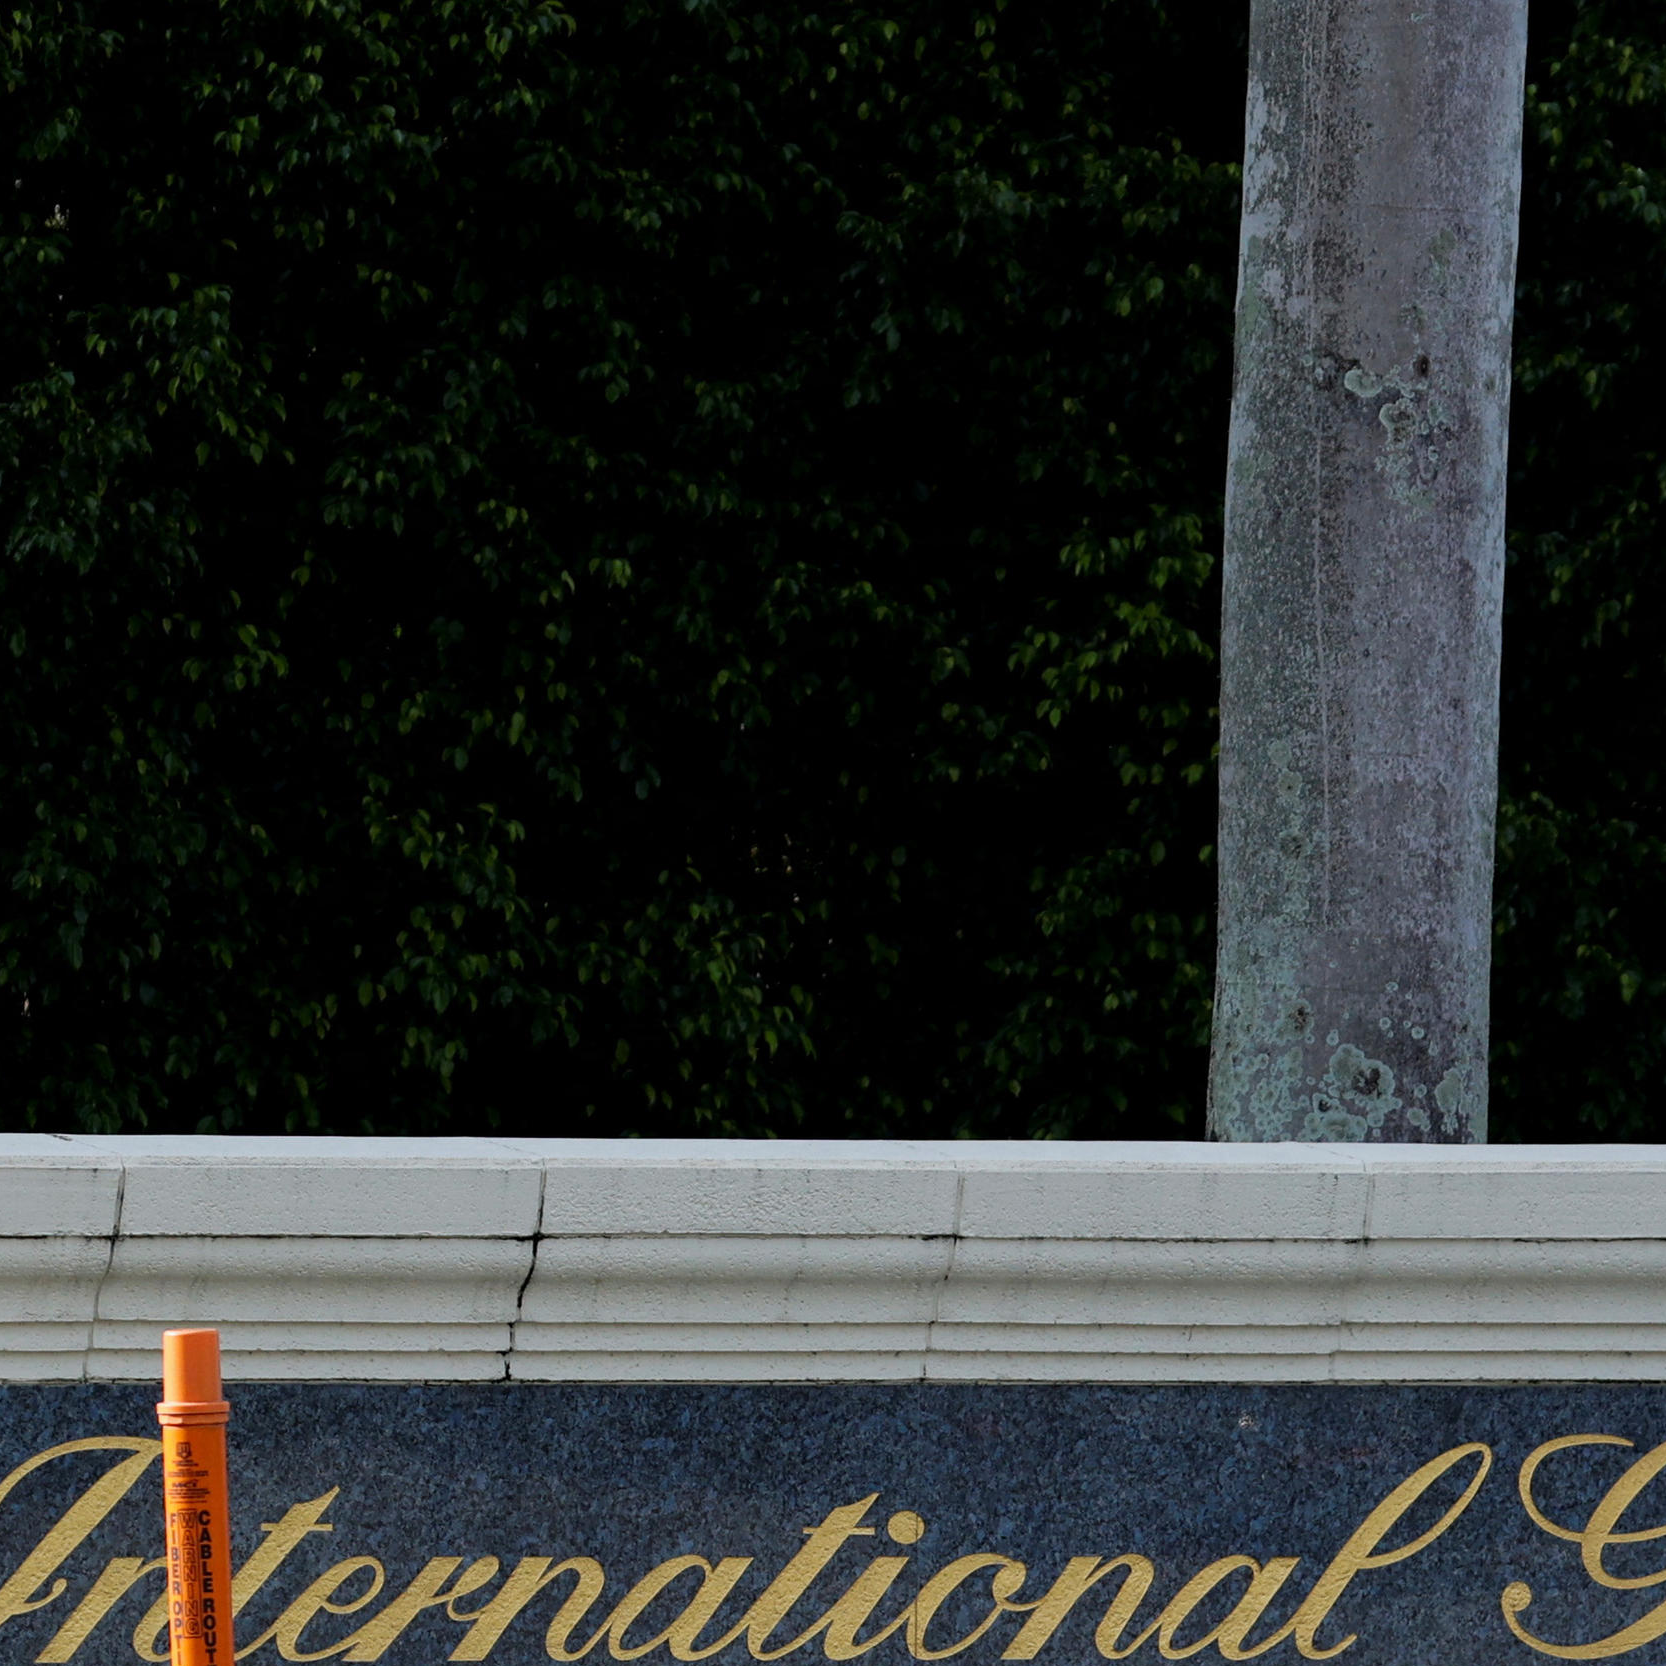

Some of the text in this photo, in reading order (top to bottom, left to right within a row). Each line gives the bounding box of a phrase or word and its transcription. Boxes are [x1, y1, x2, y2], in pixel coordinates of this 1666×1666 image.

[170, 1513, 181, 1596] FIBER
[181, 1511, 199, 1635] WARNING
[198, 1510, 214, 1593] CABLE
